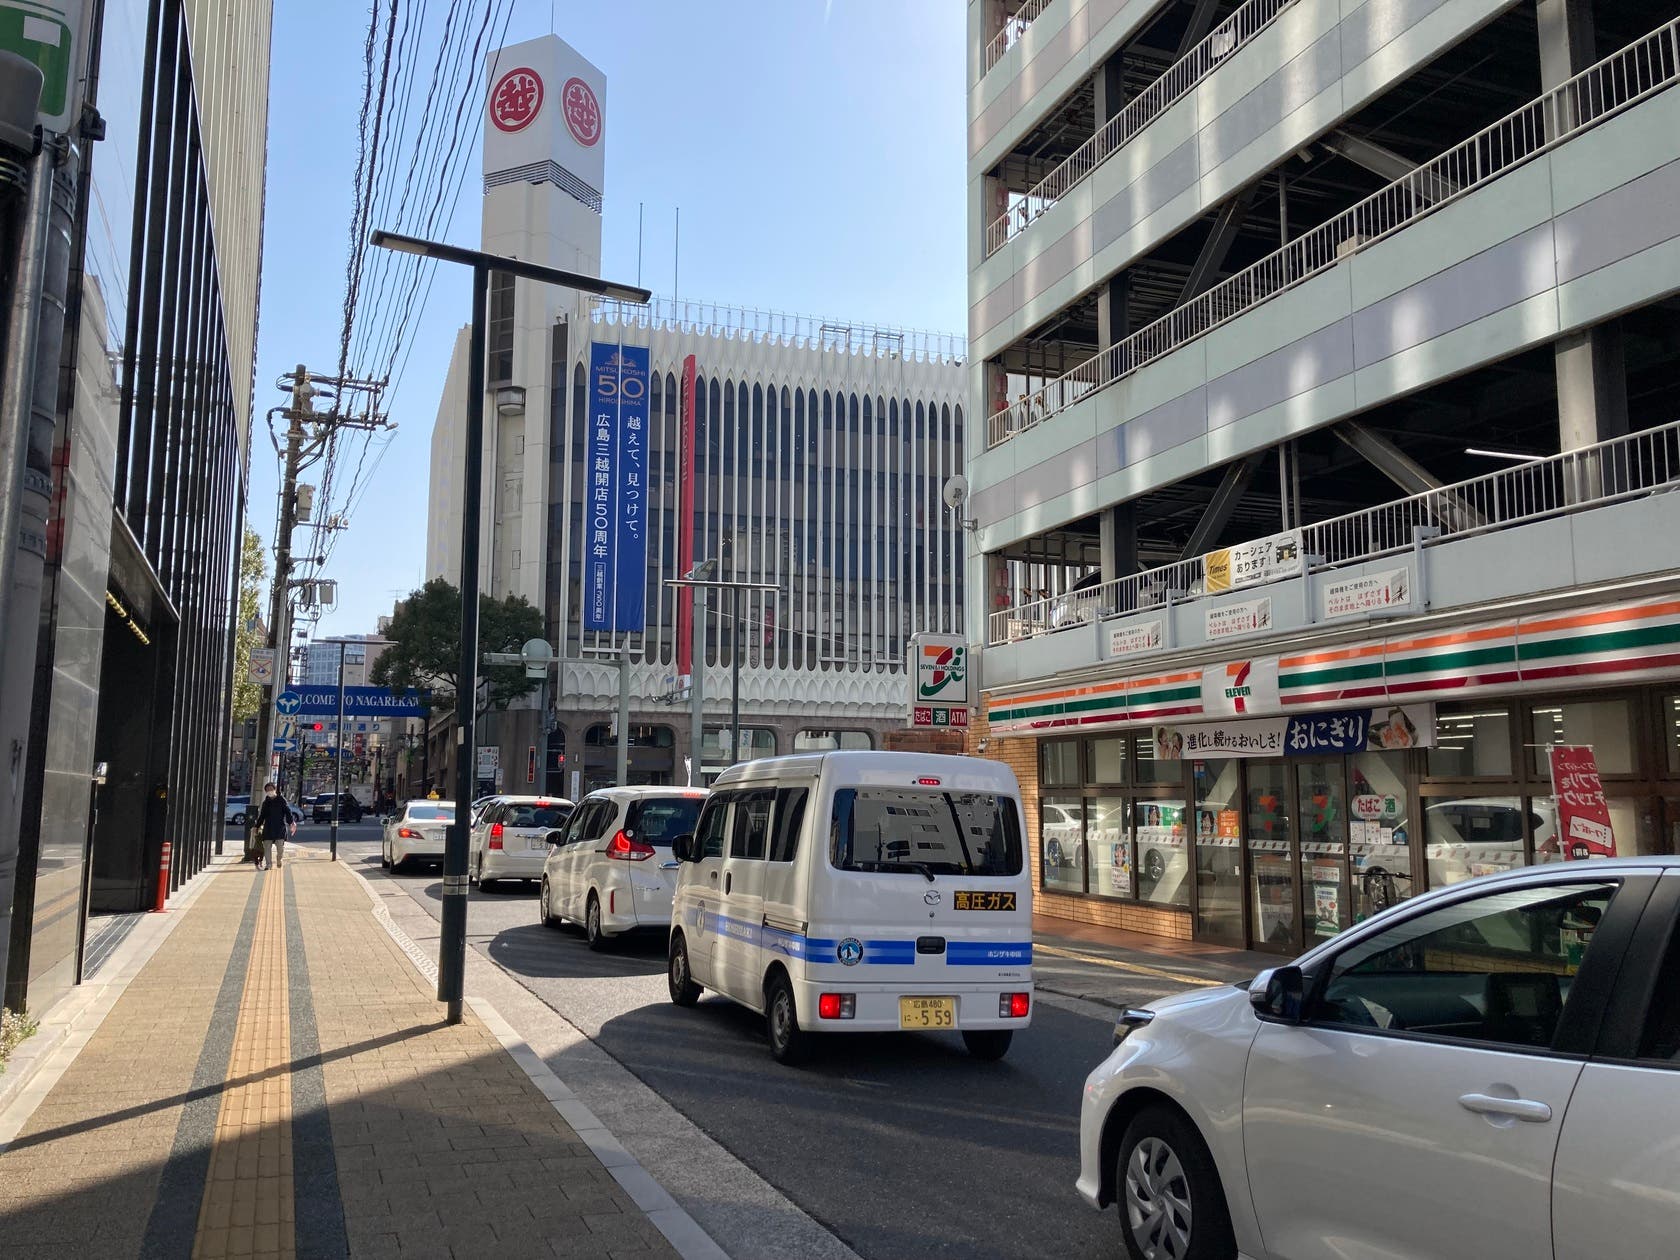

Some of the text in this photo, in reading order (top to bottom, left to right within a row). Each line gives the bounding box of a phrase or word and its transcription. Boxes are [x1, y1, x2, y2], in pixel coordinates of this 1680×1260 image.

[597, 374, 645, 399] 50
[1234, 541, 1273, 560] カーシェア
[1209, 563, 1228, 575] Times
[300, 695, 336, 705] LCOME
[915, 709, 931, 722] たばこ
[935, 710, 946, 723] 酒
[951, 711, 967, 725] ATM
[1290, 715, 1363, 750] おにぎり
[1357, 798, 1381, 813] たばこ
[1384, 798, 1396, 813] 酒
[955, 892, 1015, 910] 高圧ガス
